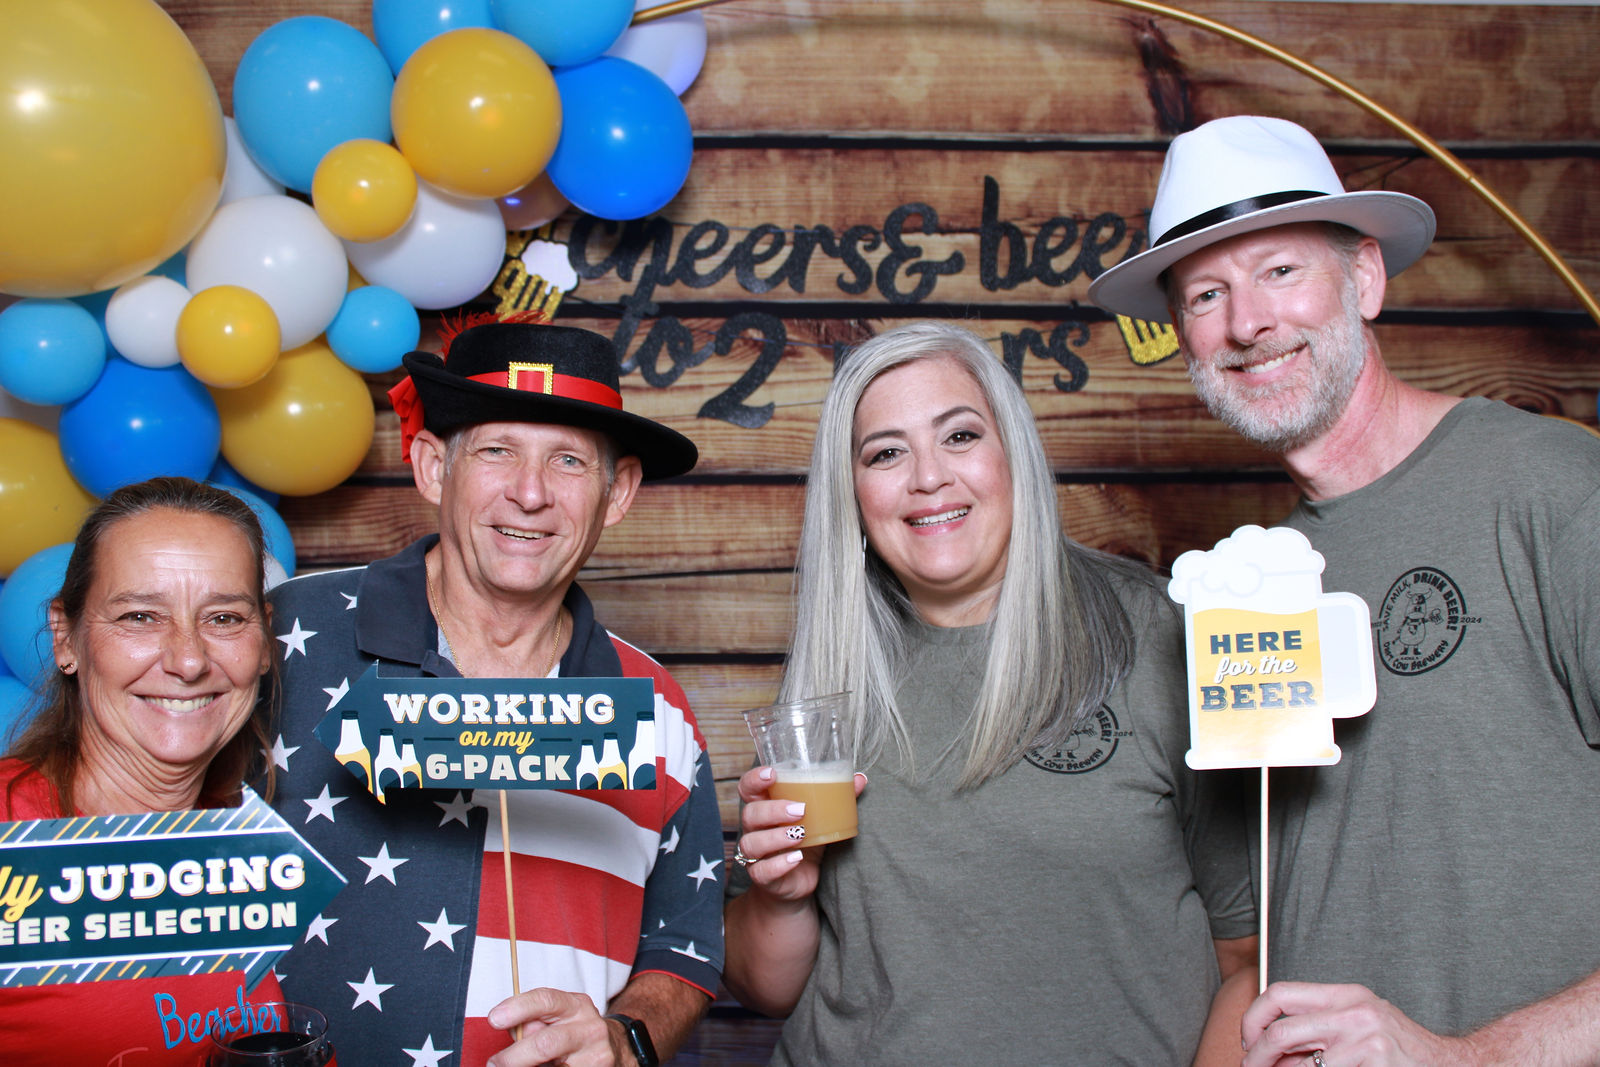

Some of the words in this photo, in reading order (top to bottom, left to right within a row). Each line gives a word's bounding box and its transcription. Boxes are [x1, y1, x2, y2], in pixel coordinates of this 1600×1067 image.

[980, 175, 1152, 291] bee
[611, 264, 714, 388] to
[1413, 573, 1447, 592] DRINK
[1442, 590, 1459, 632] BEER!
[1210, 630, 1302, 654] HERE
[1393, 658, 1409, 670] COW
[1410, 640, 1449, 671] BREWERY
[1214, 656, 1256, 684] for
[1258, 655, 1298, 674] the
[383, 693, 615, 725] WORKING
[1200, 681, 1318, 712] BEER
[459, 731, 489, 747] on
[488, 730, 535, 754] my
[425, 754, 572, 781] 6-PACK
[1044, 759, 1064, 770] COW
[1067, 748, 1104, 770] BREWERY
[49, 853, 305, 904] JUDGING
[84, 901, 297, 942] SELECTION
